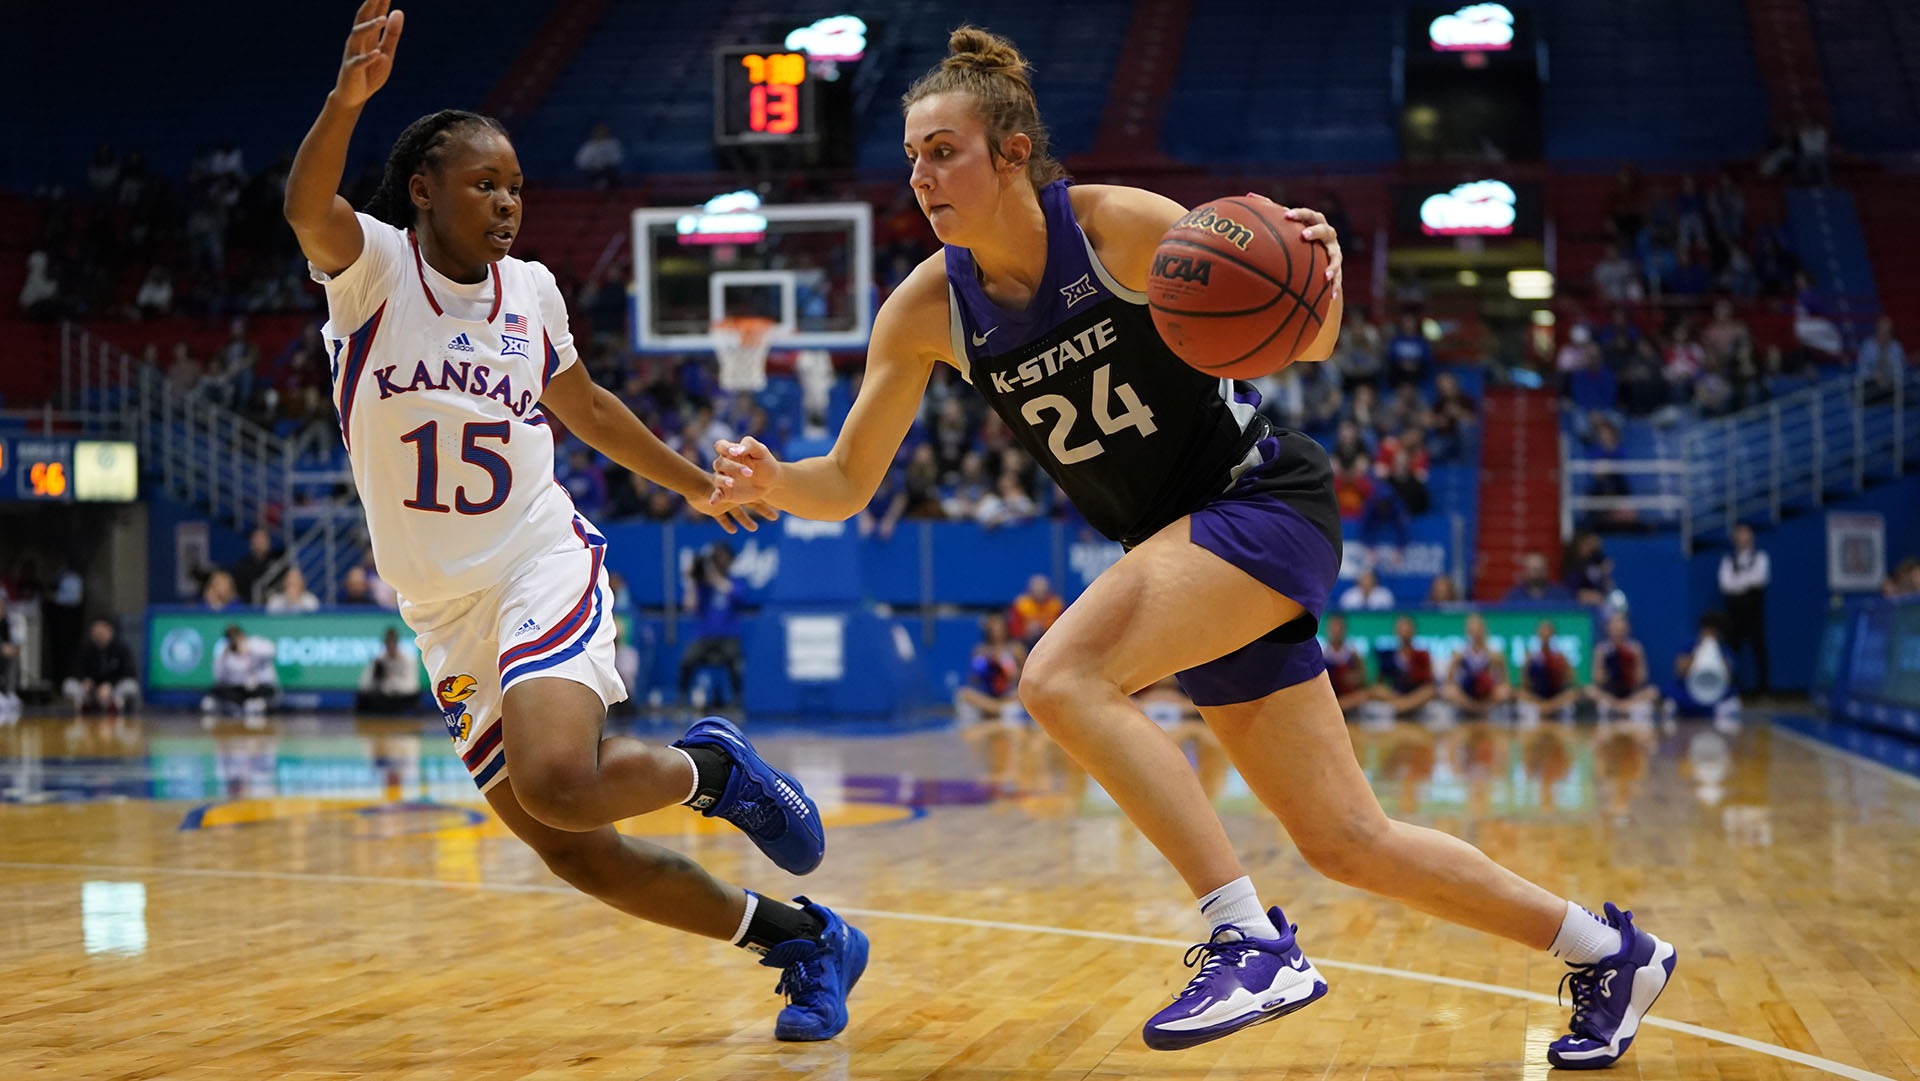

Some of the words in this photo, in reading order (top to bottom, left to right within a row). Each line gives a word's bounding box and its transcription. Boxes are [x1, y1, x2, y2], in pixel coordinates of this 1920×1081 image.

[1173, 206, 1254, 252] ilson
[1151, 254, 1211, 287] NCAA
[373, 360, 532, 417] KANSAS
[990, 317, 1117, 394] K-STATE
[1021, 363, 1158, 465] 24
[400, 420, 512, 515] 15
